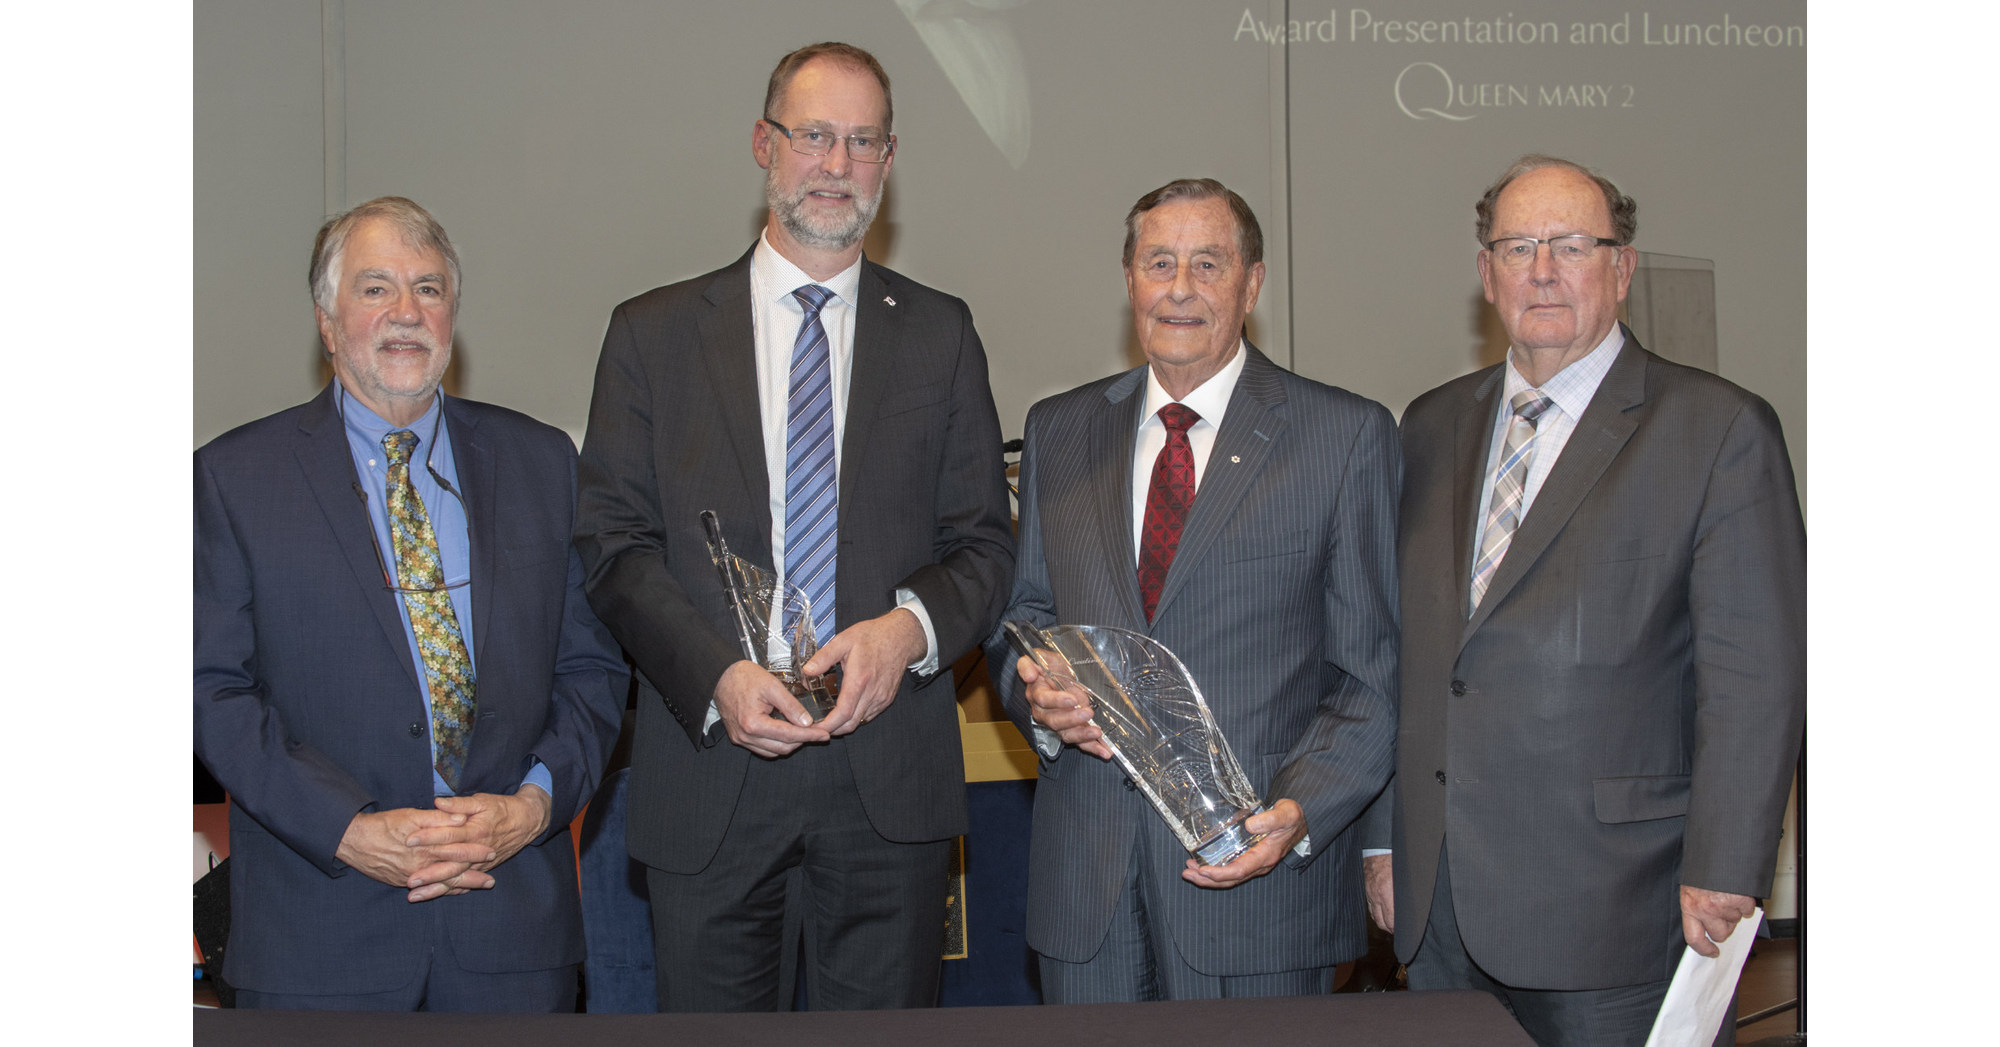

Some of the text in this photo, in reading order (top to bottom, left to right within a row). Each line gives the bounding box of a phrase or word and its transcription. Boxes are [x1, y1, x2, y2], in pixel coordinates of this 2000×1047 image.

[1233, 8, 1804, 48] Award Presentation and Luncheon
[1394, 61, 1635, 121] QUEEN MARY 2
